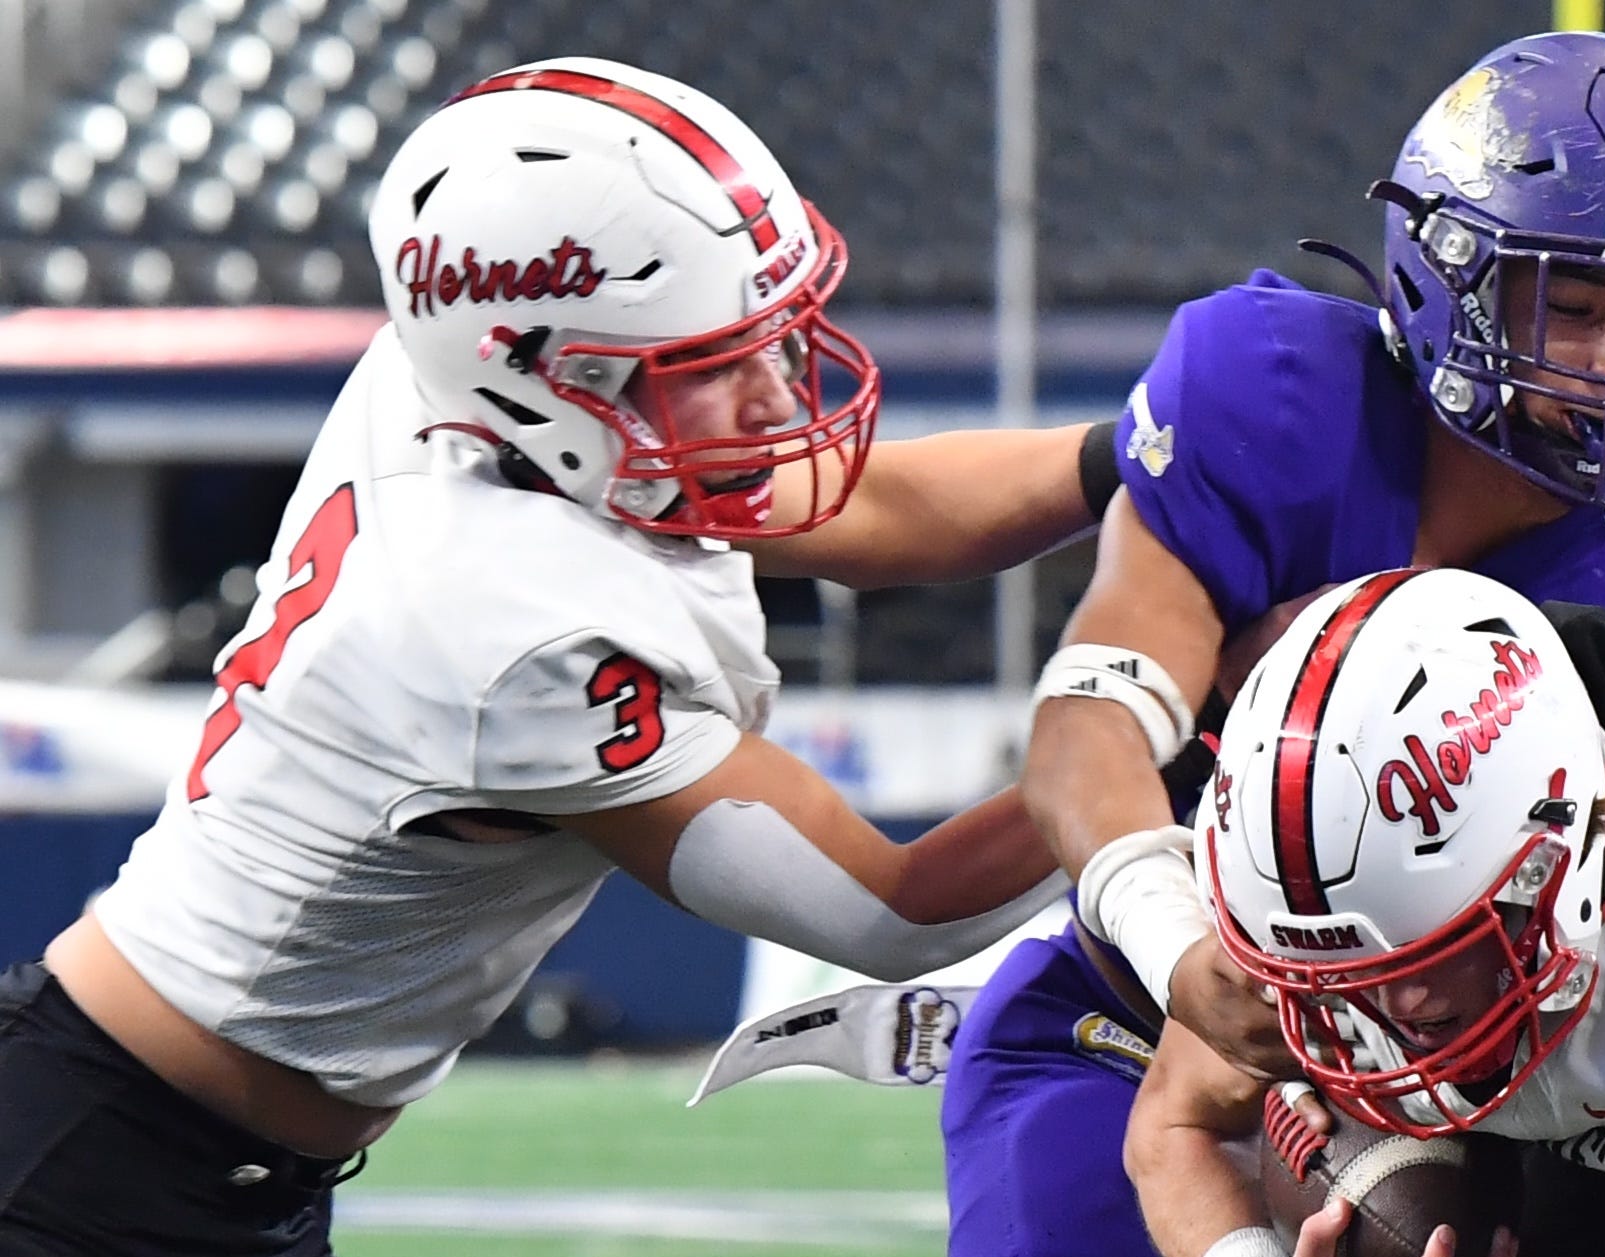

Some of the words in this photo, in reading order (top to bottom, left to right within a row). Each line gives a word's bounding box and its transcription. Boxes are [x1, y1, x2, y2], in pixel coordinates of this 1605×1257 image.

[396, 233, 607, 318] Hornets
[586, 652, 665, 775] 3
[1377, 639, 1544, 836] Hornets
[1270, 923, 1364, 950] SWARM
[1092, 1021, 1156, 1055] Shine
